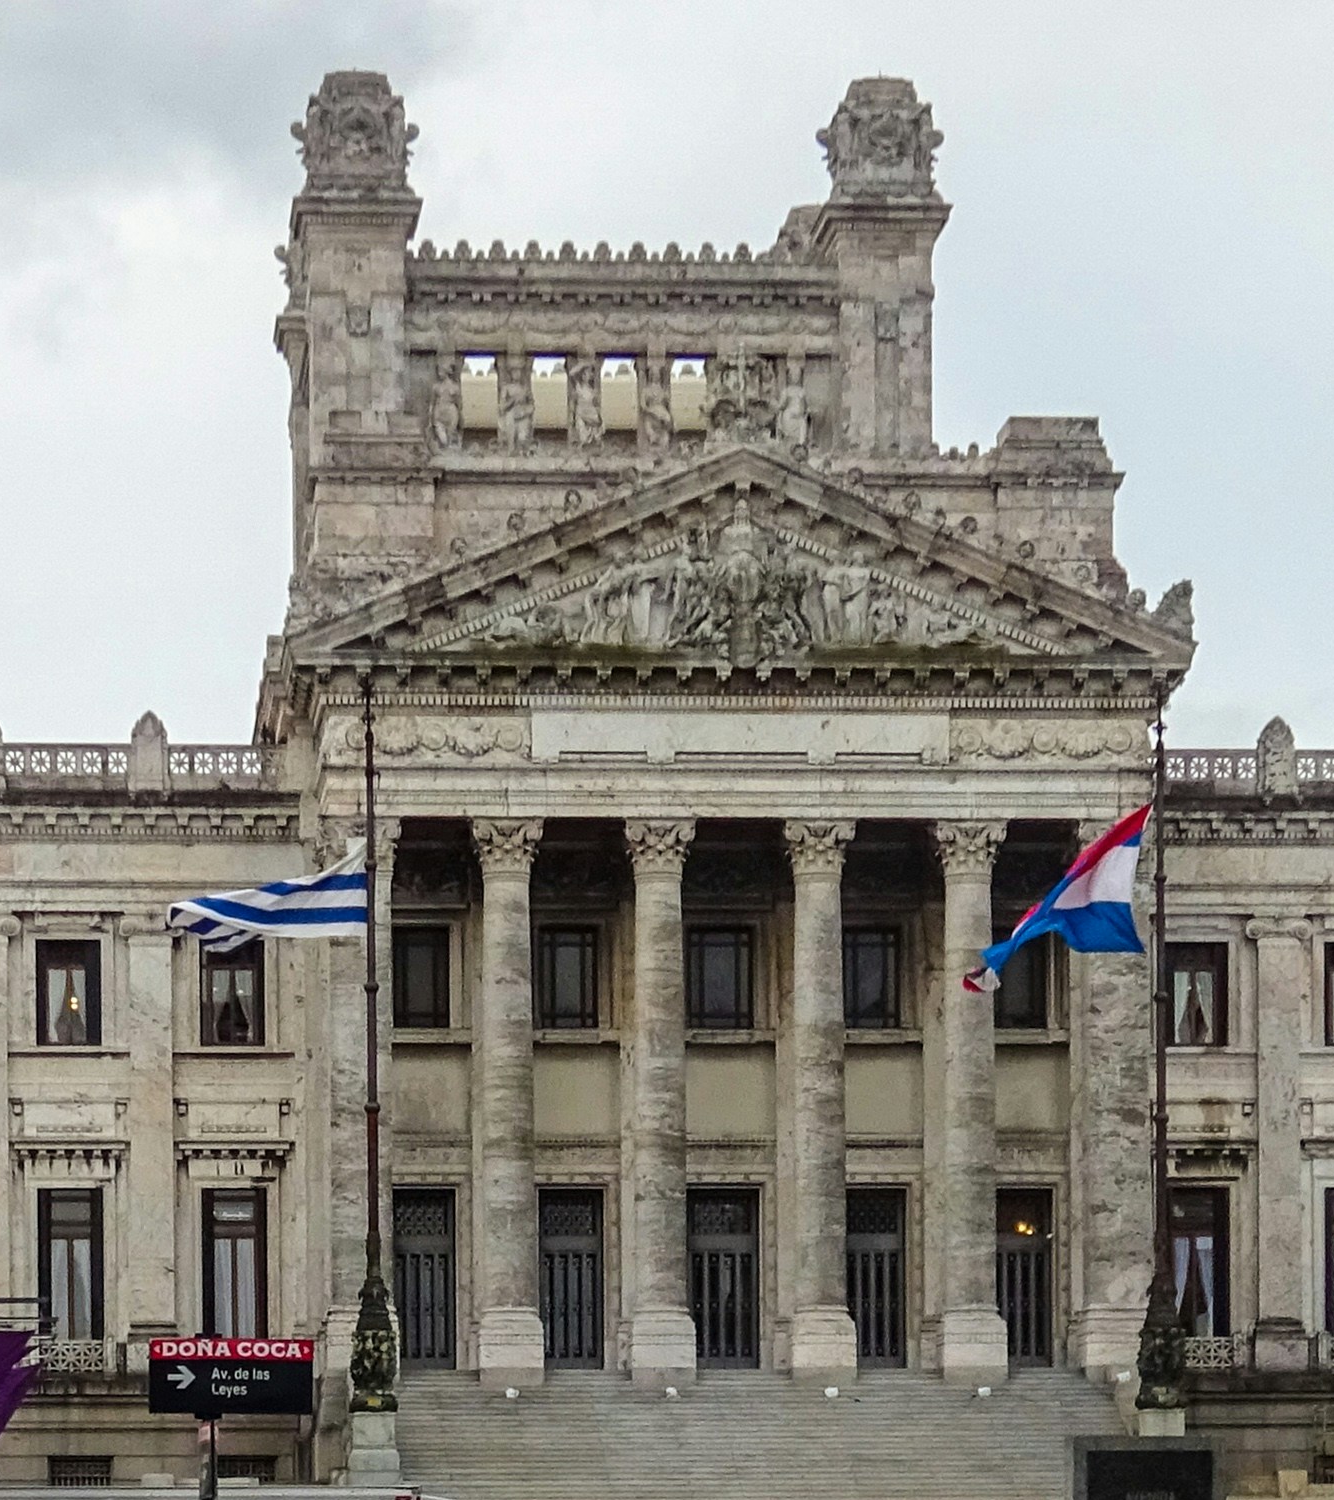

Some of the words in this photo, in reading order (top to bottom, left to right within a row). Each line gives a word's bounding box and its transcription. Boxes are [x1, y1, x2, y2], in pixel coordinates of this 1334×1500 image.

[162, 1339, 231, 1357] DOÑA
[237, 1342, 302, 1358] COCA
[211, 1367, 231, 1380] Av.
[234, 1367, 249, 1380] de
[253, 1367, 270, 1380] las
[211, 1383, 248, 1398] Leyes
